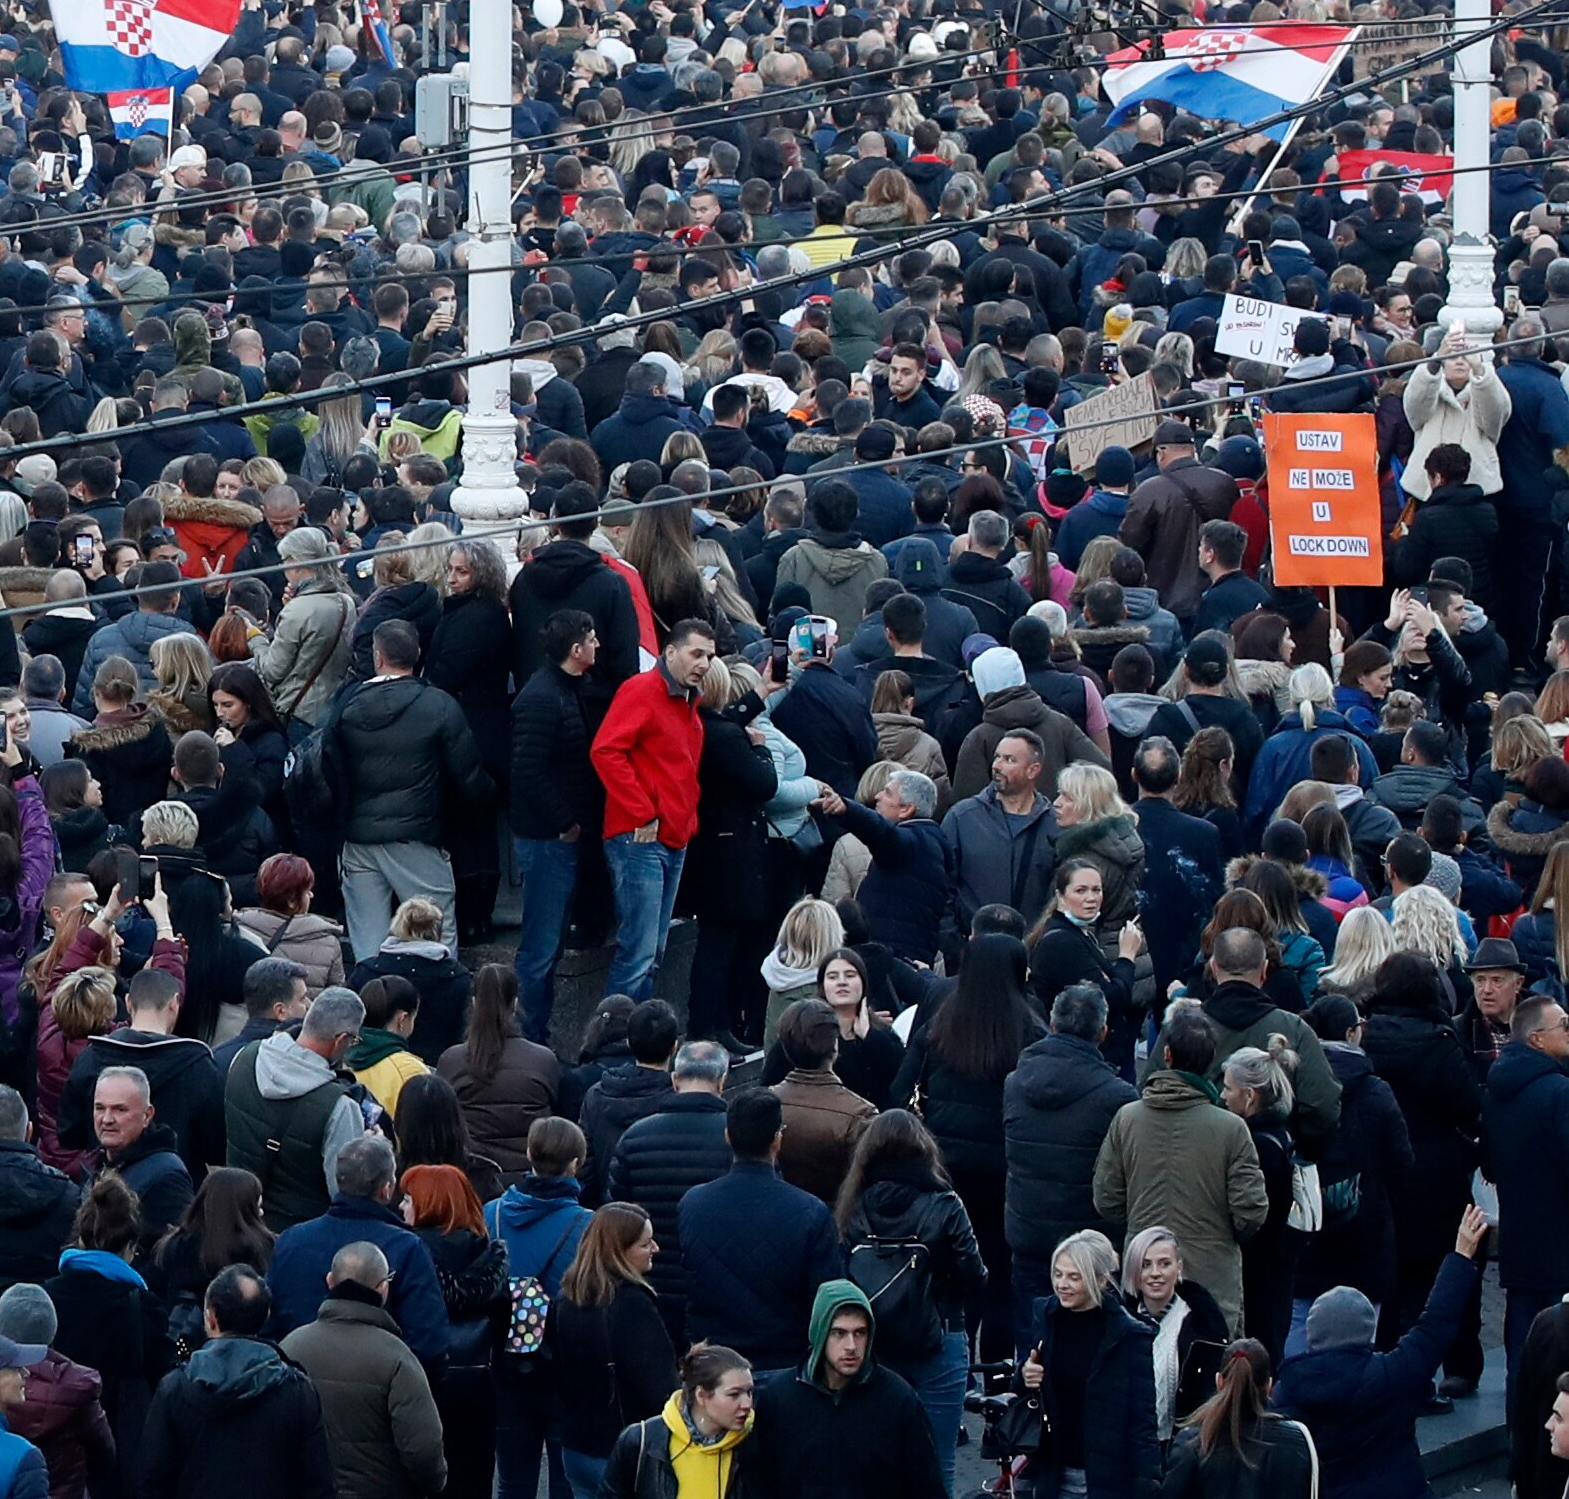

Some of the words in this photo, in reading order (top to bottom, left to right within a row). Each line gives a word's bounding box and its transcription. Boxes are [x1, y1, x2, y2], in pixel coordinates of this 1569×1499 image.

[1235, 297, 1273, 319] BUDI
[1249, 339, 1263, 356] U
[1276, 345, 1300, 364] MRA
[1299, 432, 1340, 447] USTAV
[1292, 471, 1308, 486] NE
[1315, 469, 1353, 487] MOŽE
[1316, 503, 1327, 519] U
